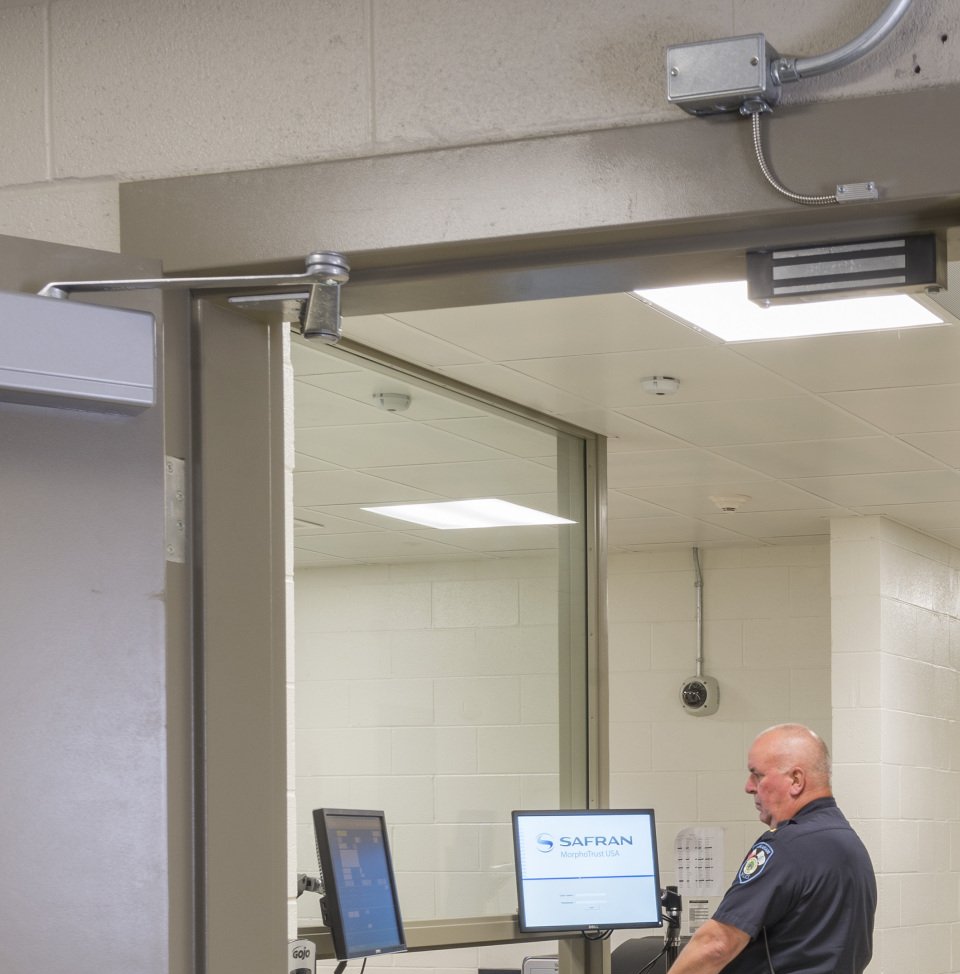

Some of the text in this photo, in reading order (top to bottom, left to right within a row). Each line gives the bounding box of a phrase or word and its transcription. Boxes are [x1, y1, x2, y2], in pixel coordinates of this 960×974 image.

[559, 835, 633, 847] SAFRAN
[560, 849, 620, 859] MorphoTrust USA
